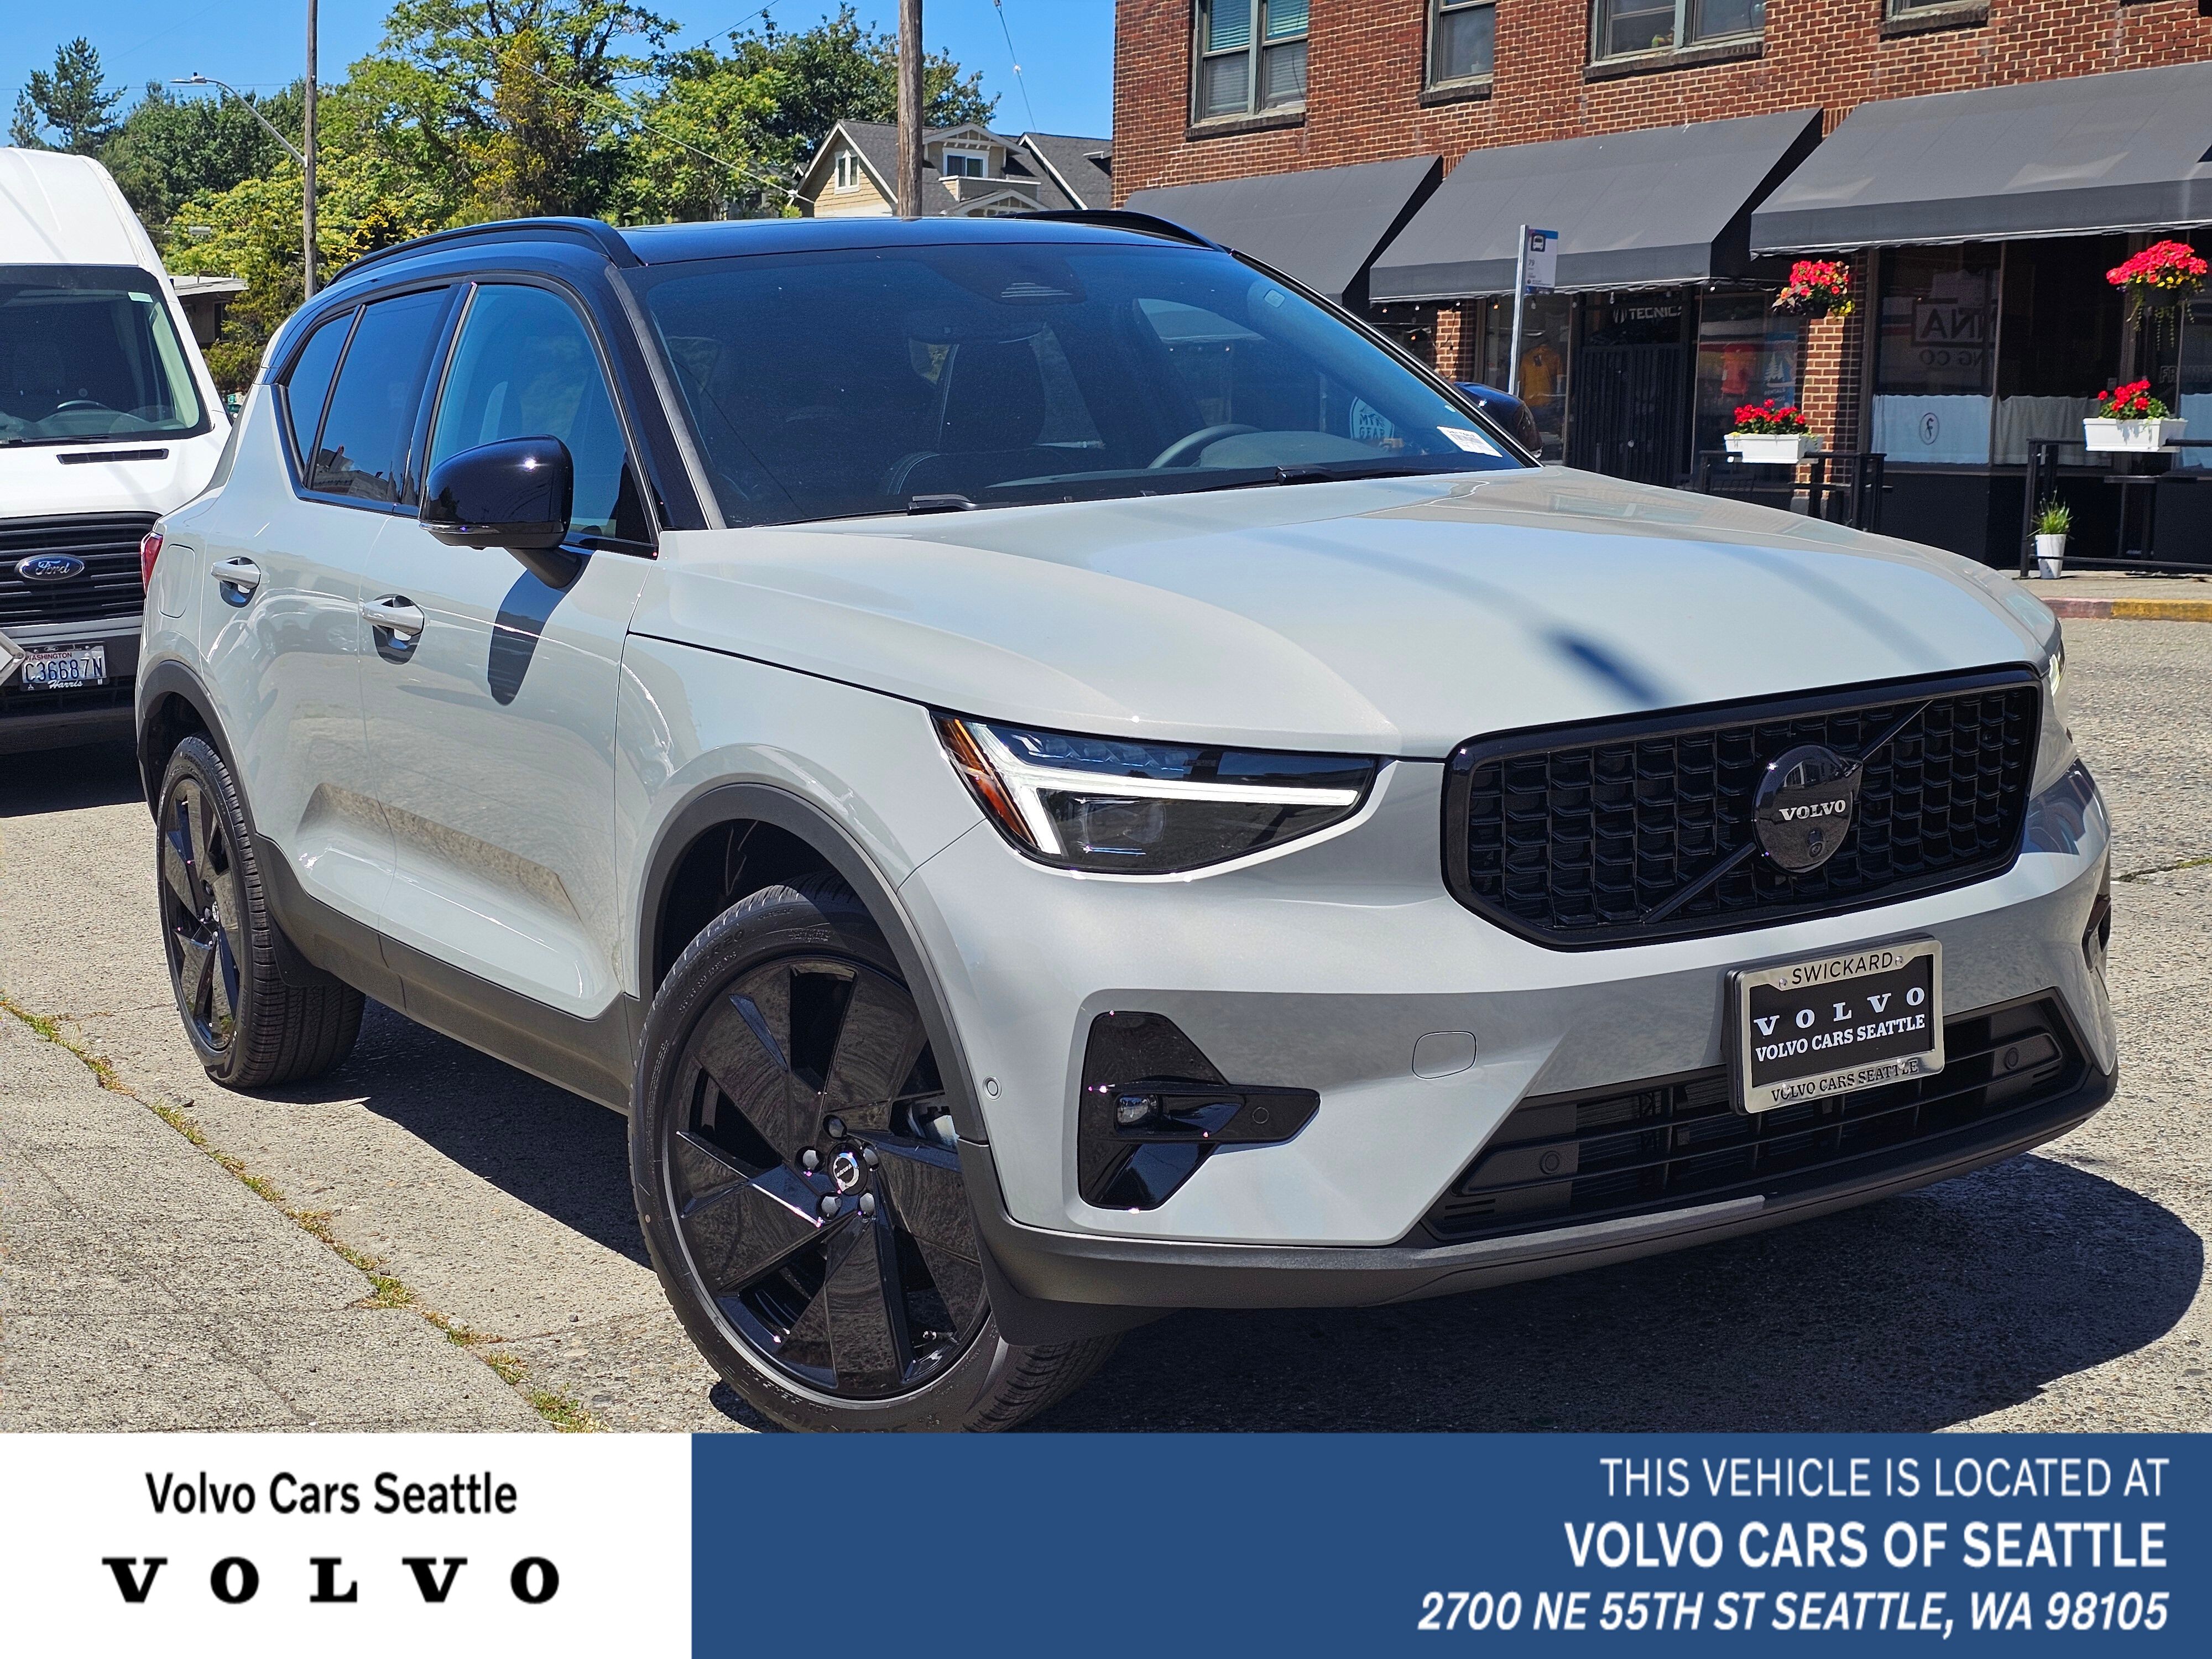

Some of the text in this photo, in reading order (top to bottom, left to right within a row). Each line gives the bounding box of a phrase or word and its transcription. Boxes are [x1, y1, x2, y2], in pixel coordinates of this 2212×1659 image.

[35, 560, 70, 575] Ford
[25, 652, 72, 661] WASHINGTON
[25, 656, 103, 682] C36687N
[48, 679, 84, 689] Harris
[1778, 800, 1846, 821] VOLVO
[1792, 952, 1893, 984] SWICKARD
[1754, 987, 1925, 1036] VOLVO
[1755, 1014, 1925, 1062] VOLVO CARS SEATTLE
[1771, 1060, 1919, 1101] VOLVO CARS SEATTLE
